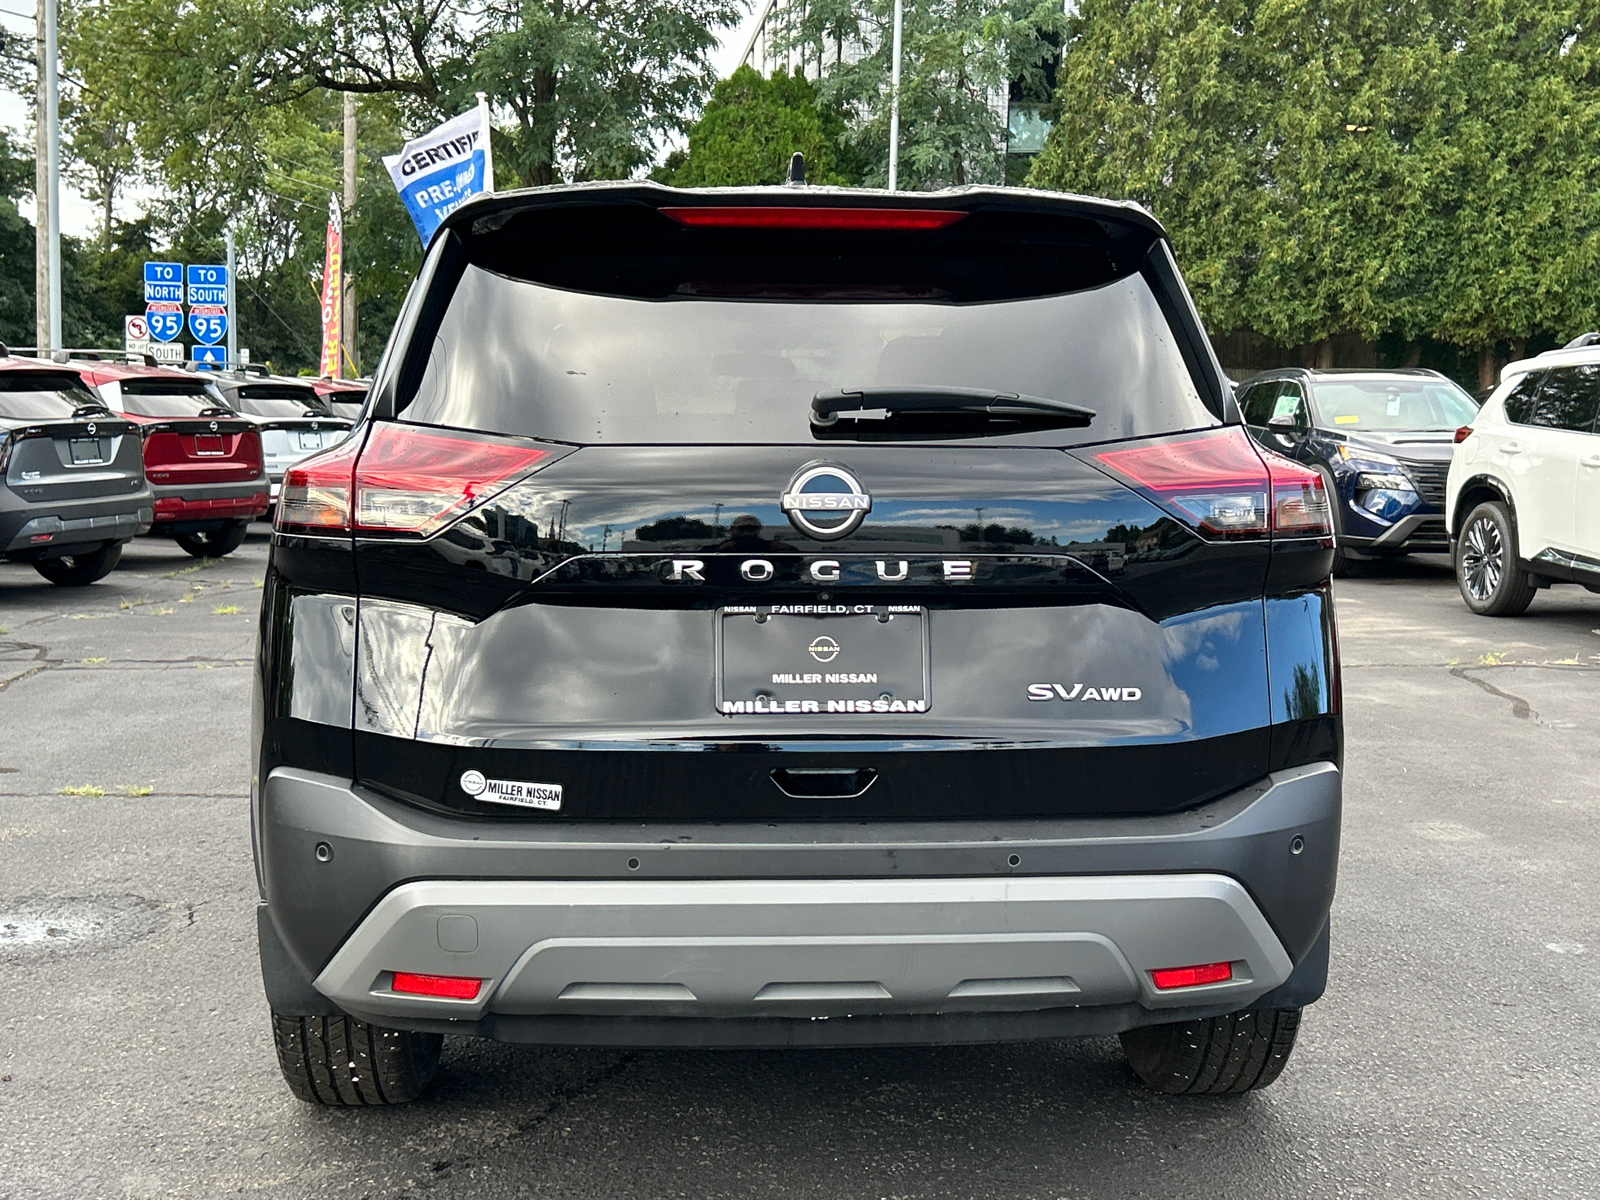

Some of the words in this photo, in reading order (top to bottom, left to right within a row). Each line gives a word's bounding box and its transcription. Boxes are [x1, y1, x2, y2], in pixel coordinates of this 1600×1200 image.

[155, 266, 173, 279] TO
[198, 269, 217, 282] TO
[147, 284, 182, 299] NORTH
[190, 287, 225, 302] SOUTH
[151, 316, 178, 335] 95
[195, 319, 222, 338] 95
[148, 346, 181, 360] SOUTH
[786, 497, 868, 508] NISSAN
[666, 560, 974, 581] ROGUE
[723, 605, 756, 613] NISSAN
[771, 605, 850, 615] FAIRFIELD,
[855, 605, 874, 614] CT
[888, 605, 921, 613] NISSAN
[772, 673, 822, 684] MILLER
[825, 673, 877, 684] NISSAN
[1027, 683, 1084, 701] SV
[1081, 687, 1142, 701] AWD
[722, 700, 819, 713] MILLER
[827, 700, 926, 713] NISSAN
[488, 782, 523, 797] MILLER
[526, 786, 561, 802] NISSAN
